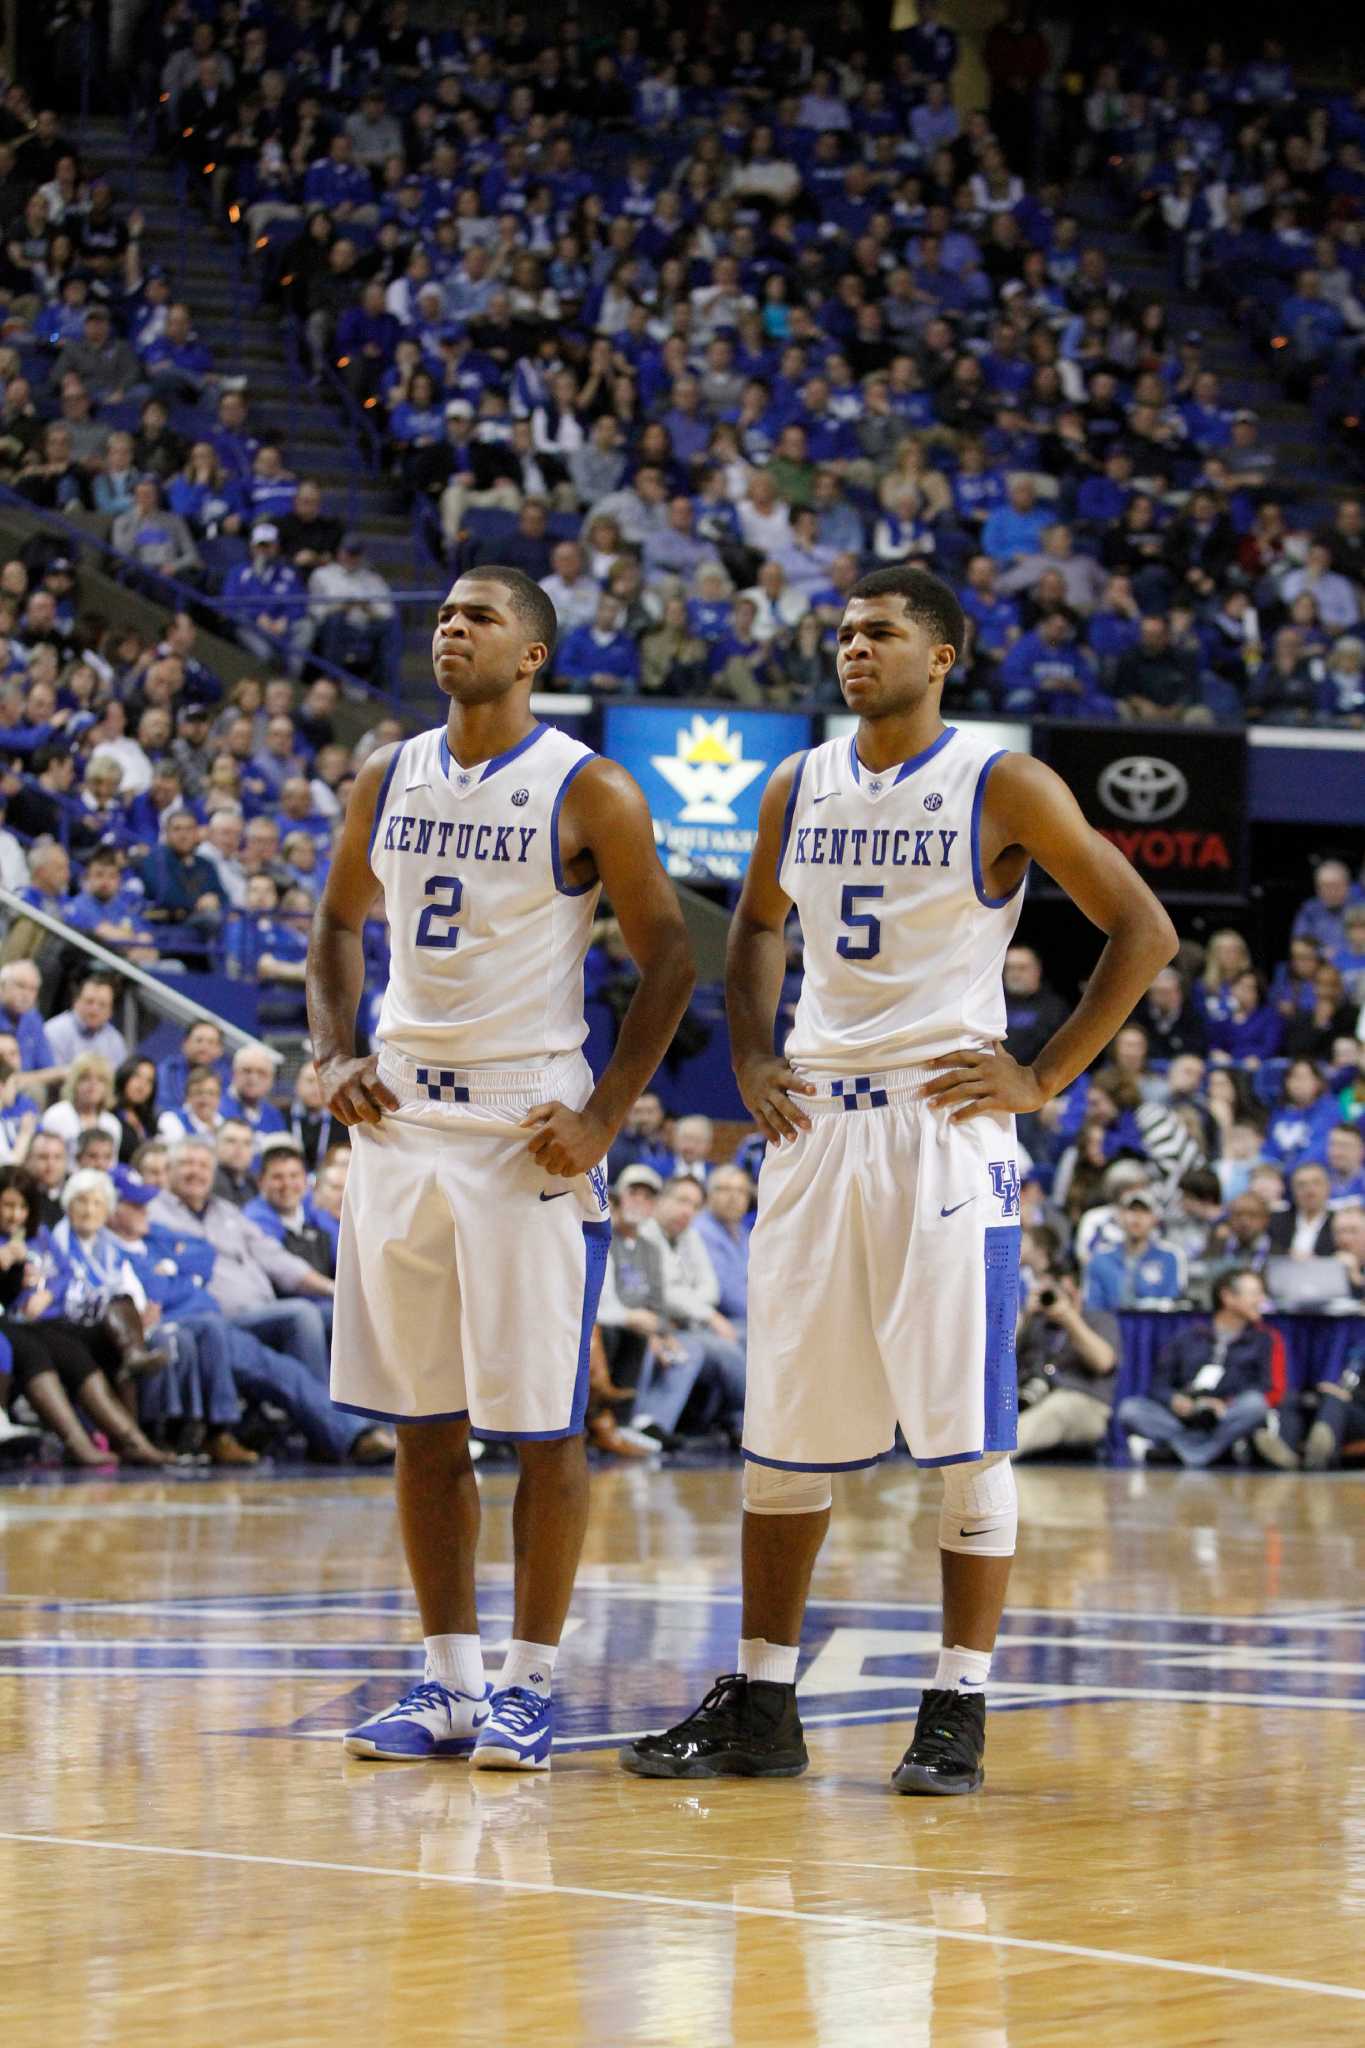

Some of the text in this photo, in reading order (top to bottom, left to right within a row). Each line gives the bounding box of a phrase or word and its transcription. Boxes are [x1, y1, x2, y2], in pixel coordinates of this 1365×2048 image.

[384, 816, 537, 862] KENTUCKY
[795, 828, 958, 867] KENTUCKY
[1100, 828, 1232, 869] YOTA
[416, 875, 463, 948] 2
[836, 885, 884, 960] 5
